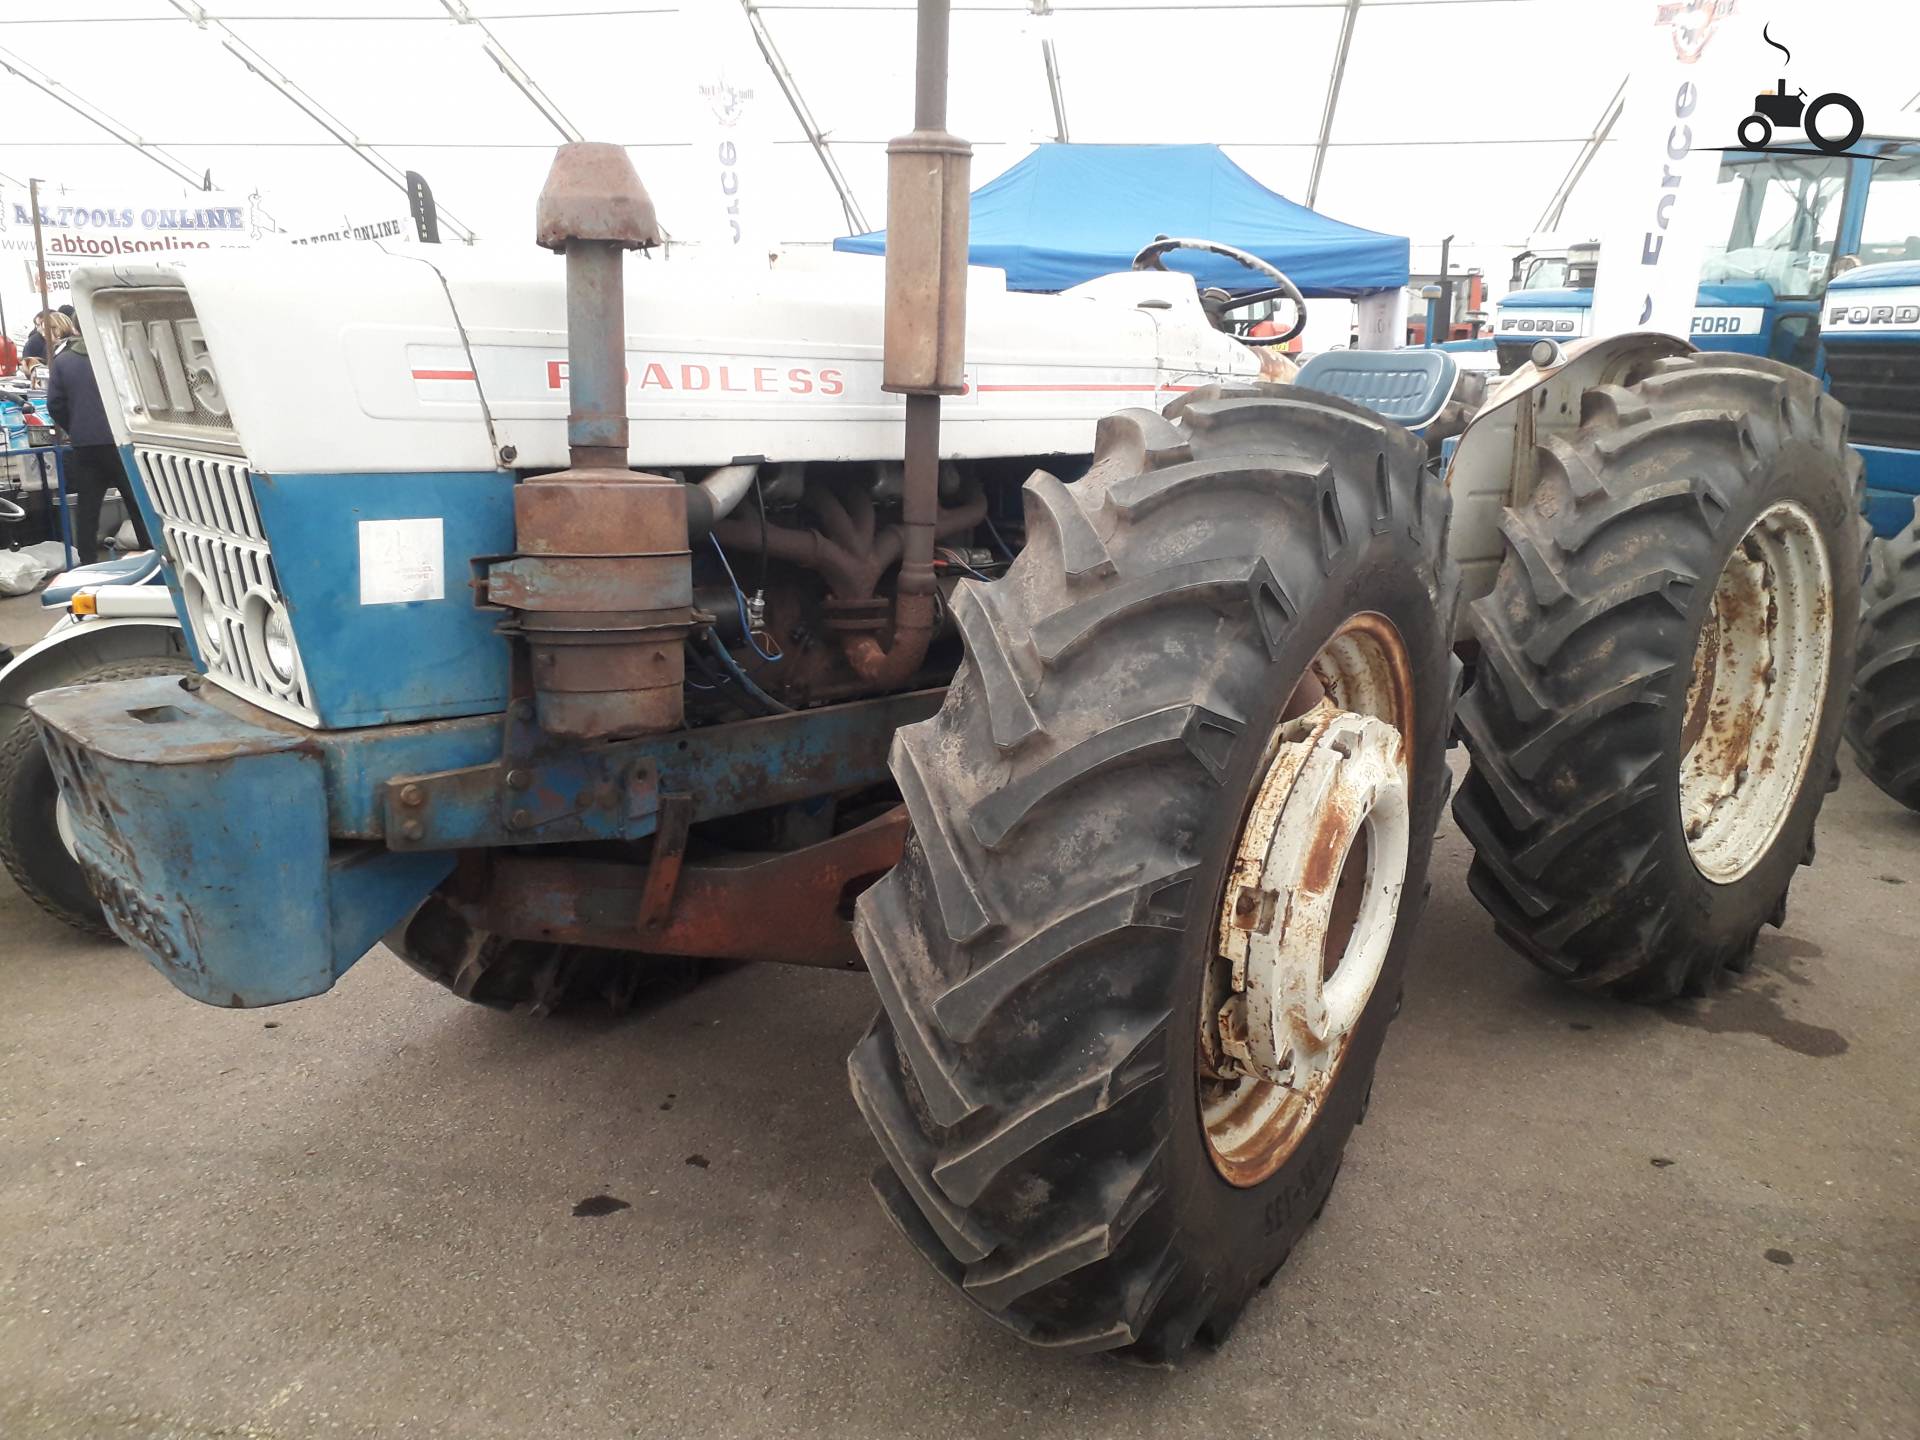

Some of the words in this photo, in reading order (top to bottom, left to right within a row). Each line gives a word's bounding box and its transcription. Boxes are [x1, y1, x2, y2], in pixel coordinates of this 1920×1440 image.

[141, 206, 244, 230] ONLINE
[353, 219, 400, 241] ONLINE
[1501, 319, 1574, 332] FORD
[1689, 316, 1741, 333] FORD
[1829, 305, 1920, 325] FORD
[547, 361, 843, 395] RADLESS
